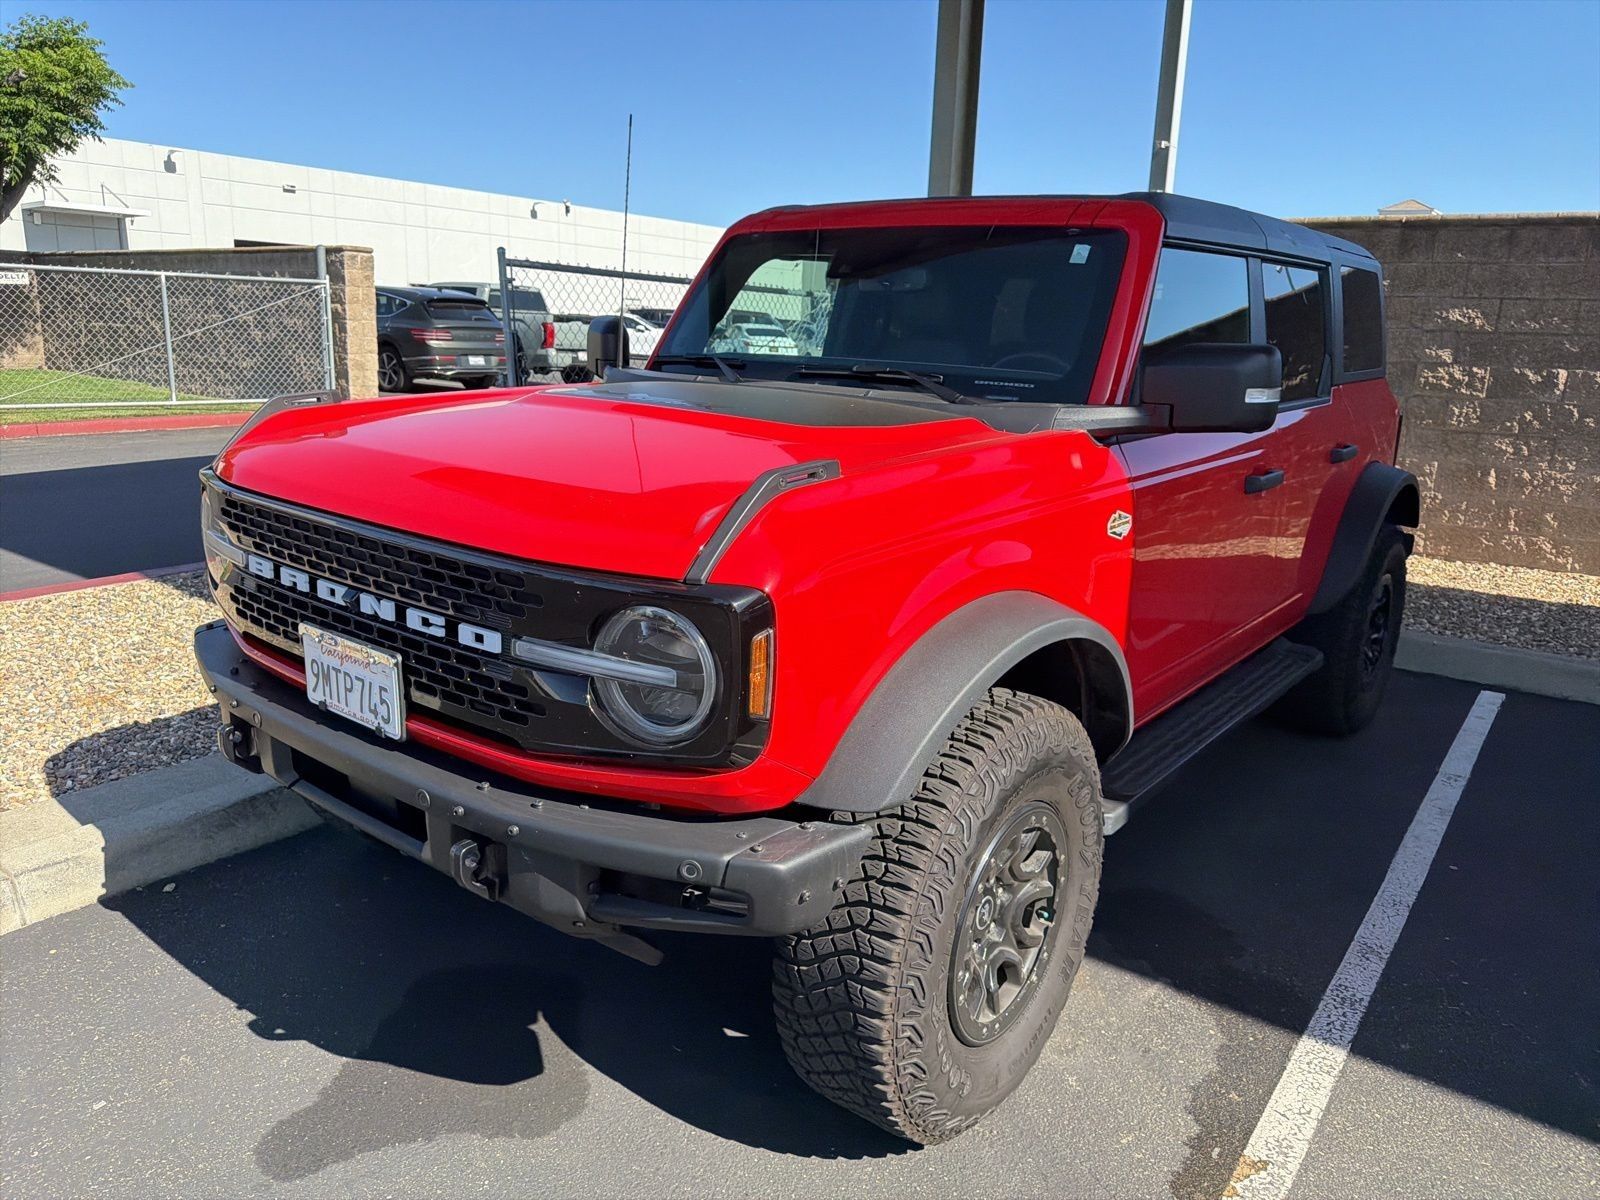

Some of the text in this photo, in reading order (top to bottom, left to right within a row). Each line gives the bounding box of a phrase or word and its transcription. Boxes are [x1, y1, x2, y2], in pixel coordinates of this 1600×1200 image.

[974, 380, 1035, 388] BRONCO
[249, 554, 502, 654] BRONCO
[320, 643, 372, 669] California
[310, 658, 391, 724] 9MTP745
